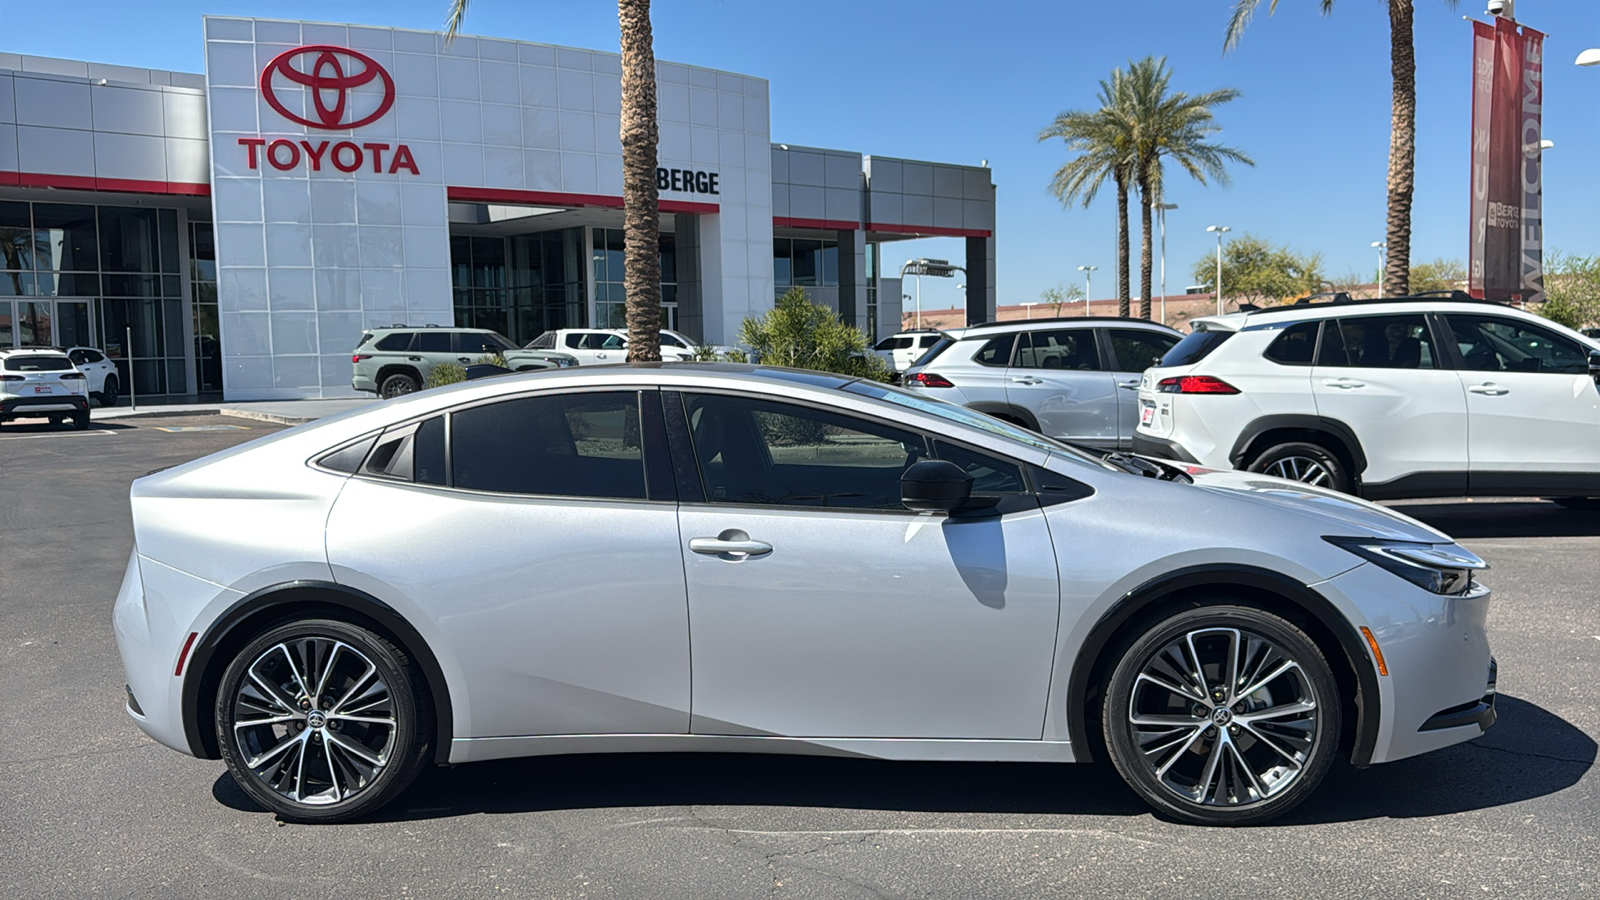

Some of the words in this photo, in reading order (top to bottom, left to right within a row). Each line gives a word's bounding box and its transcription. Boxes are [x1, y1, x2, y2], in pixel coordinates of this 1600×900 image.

[238, 138, 420, 175] TOYOTA
[1521, 36, 1545, 303] WELCOME
[656, 167, 720, 195] BERGE
